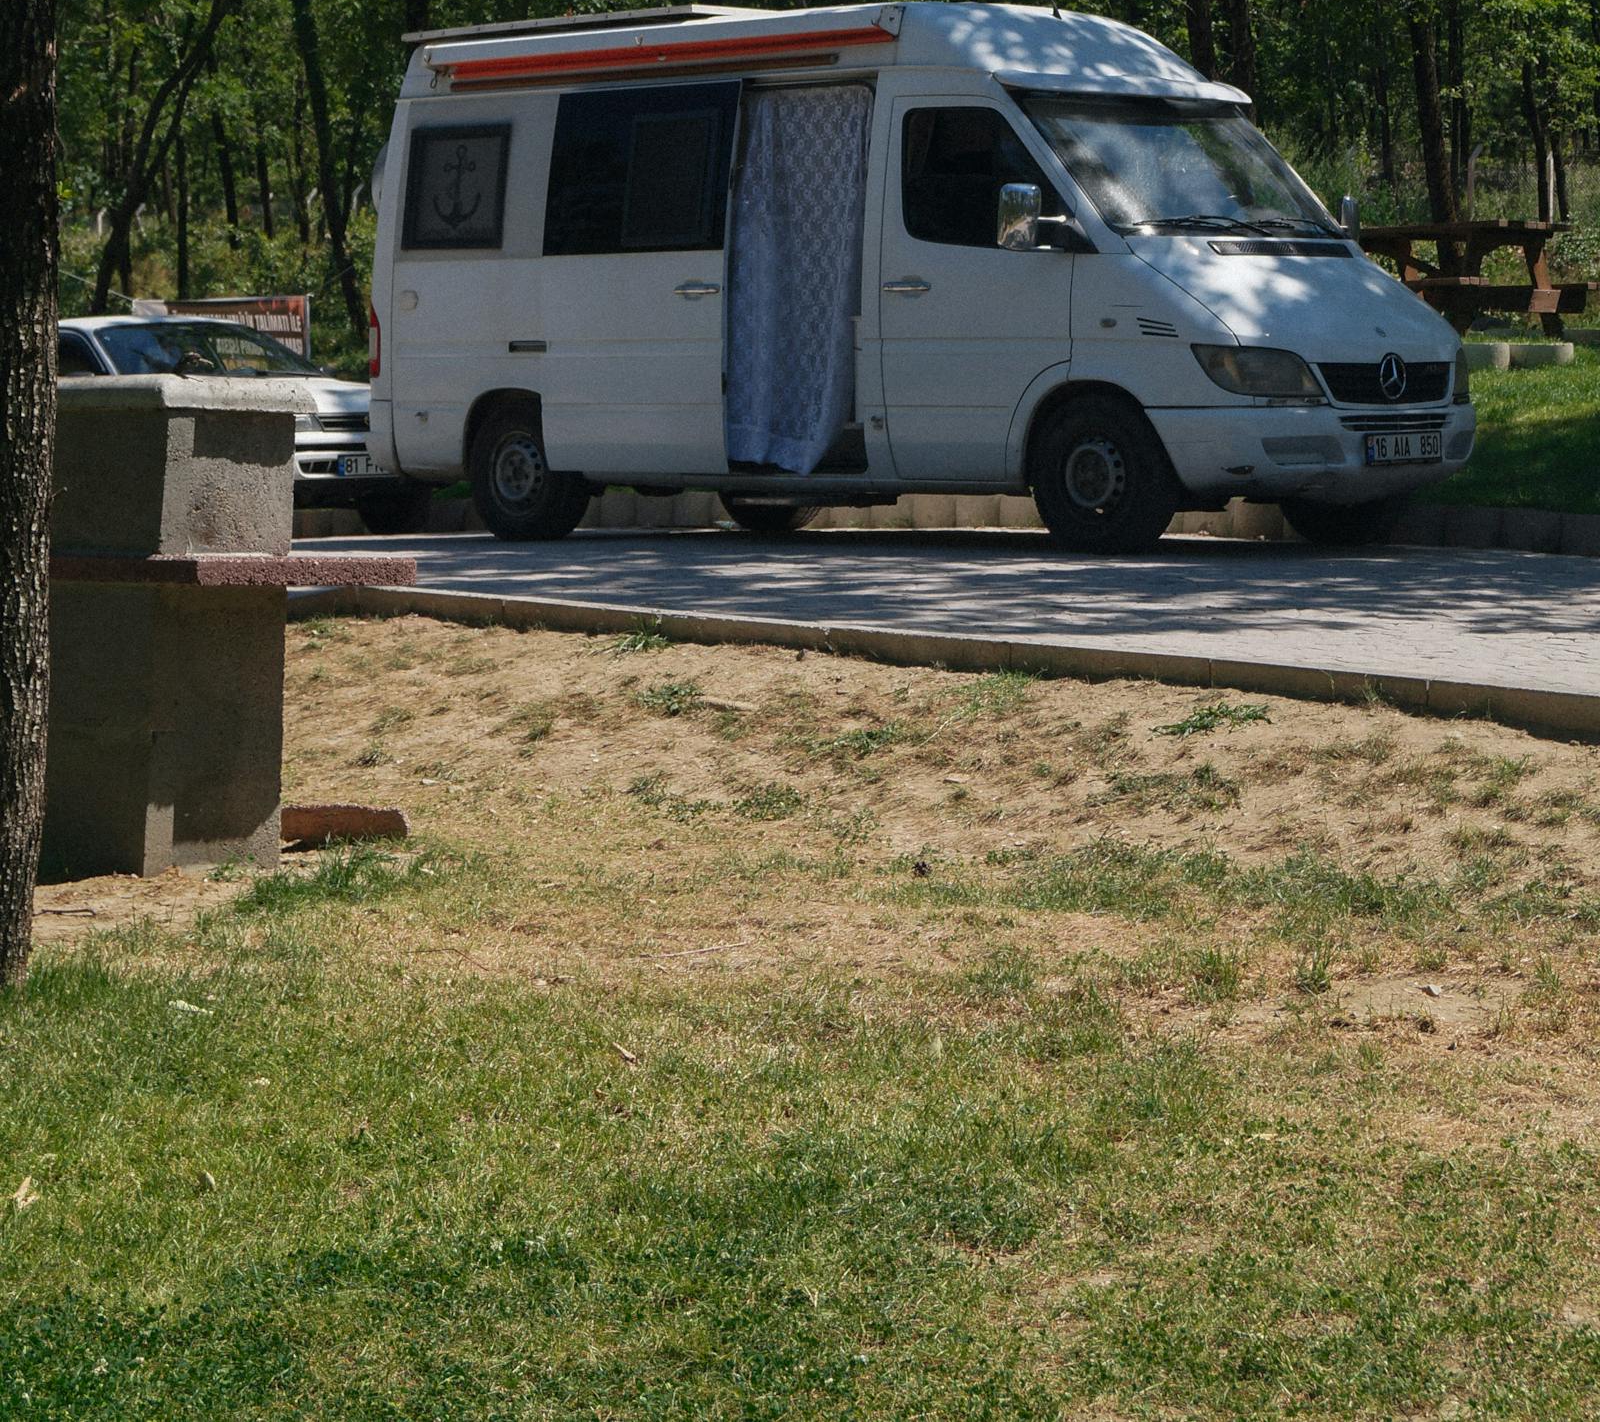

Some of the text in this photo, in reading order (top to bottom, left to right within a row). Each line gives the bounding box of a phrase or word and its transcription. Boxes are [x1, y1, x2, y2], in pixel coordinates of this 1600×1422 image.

[1375, 435, 1439, 458] 16 AIA 850
[346, 458, 358, 473] 81
